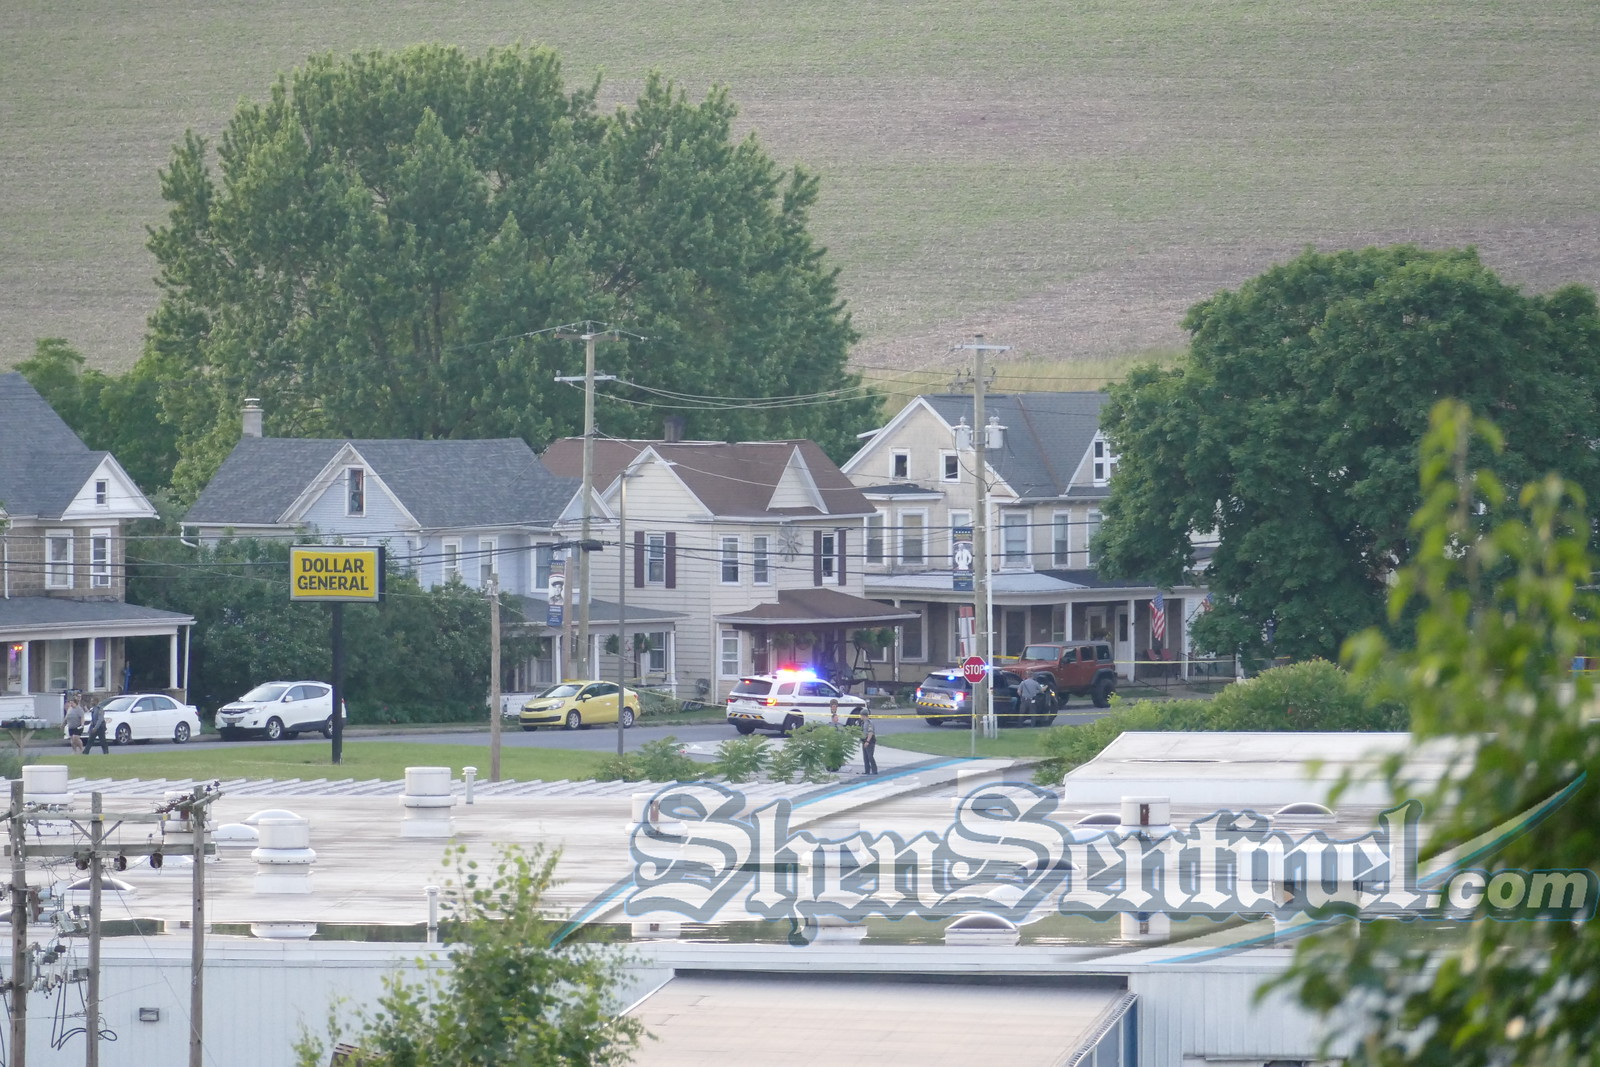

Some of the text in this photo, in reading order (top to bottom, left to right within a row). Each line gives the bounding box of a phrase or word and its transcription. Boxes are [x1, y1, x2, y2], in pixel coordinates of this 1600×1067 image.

[302, 558, 364, 573] DOLLAR
[297, 575, 369, 590] GENERAL
[965, 664, 985, 675] STOP
